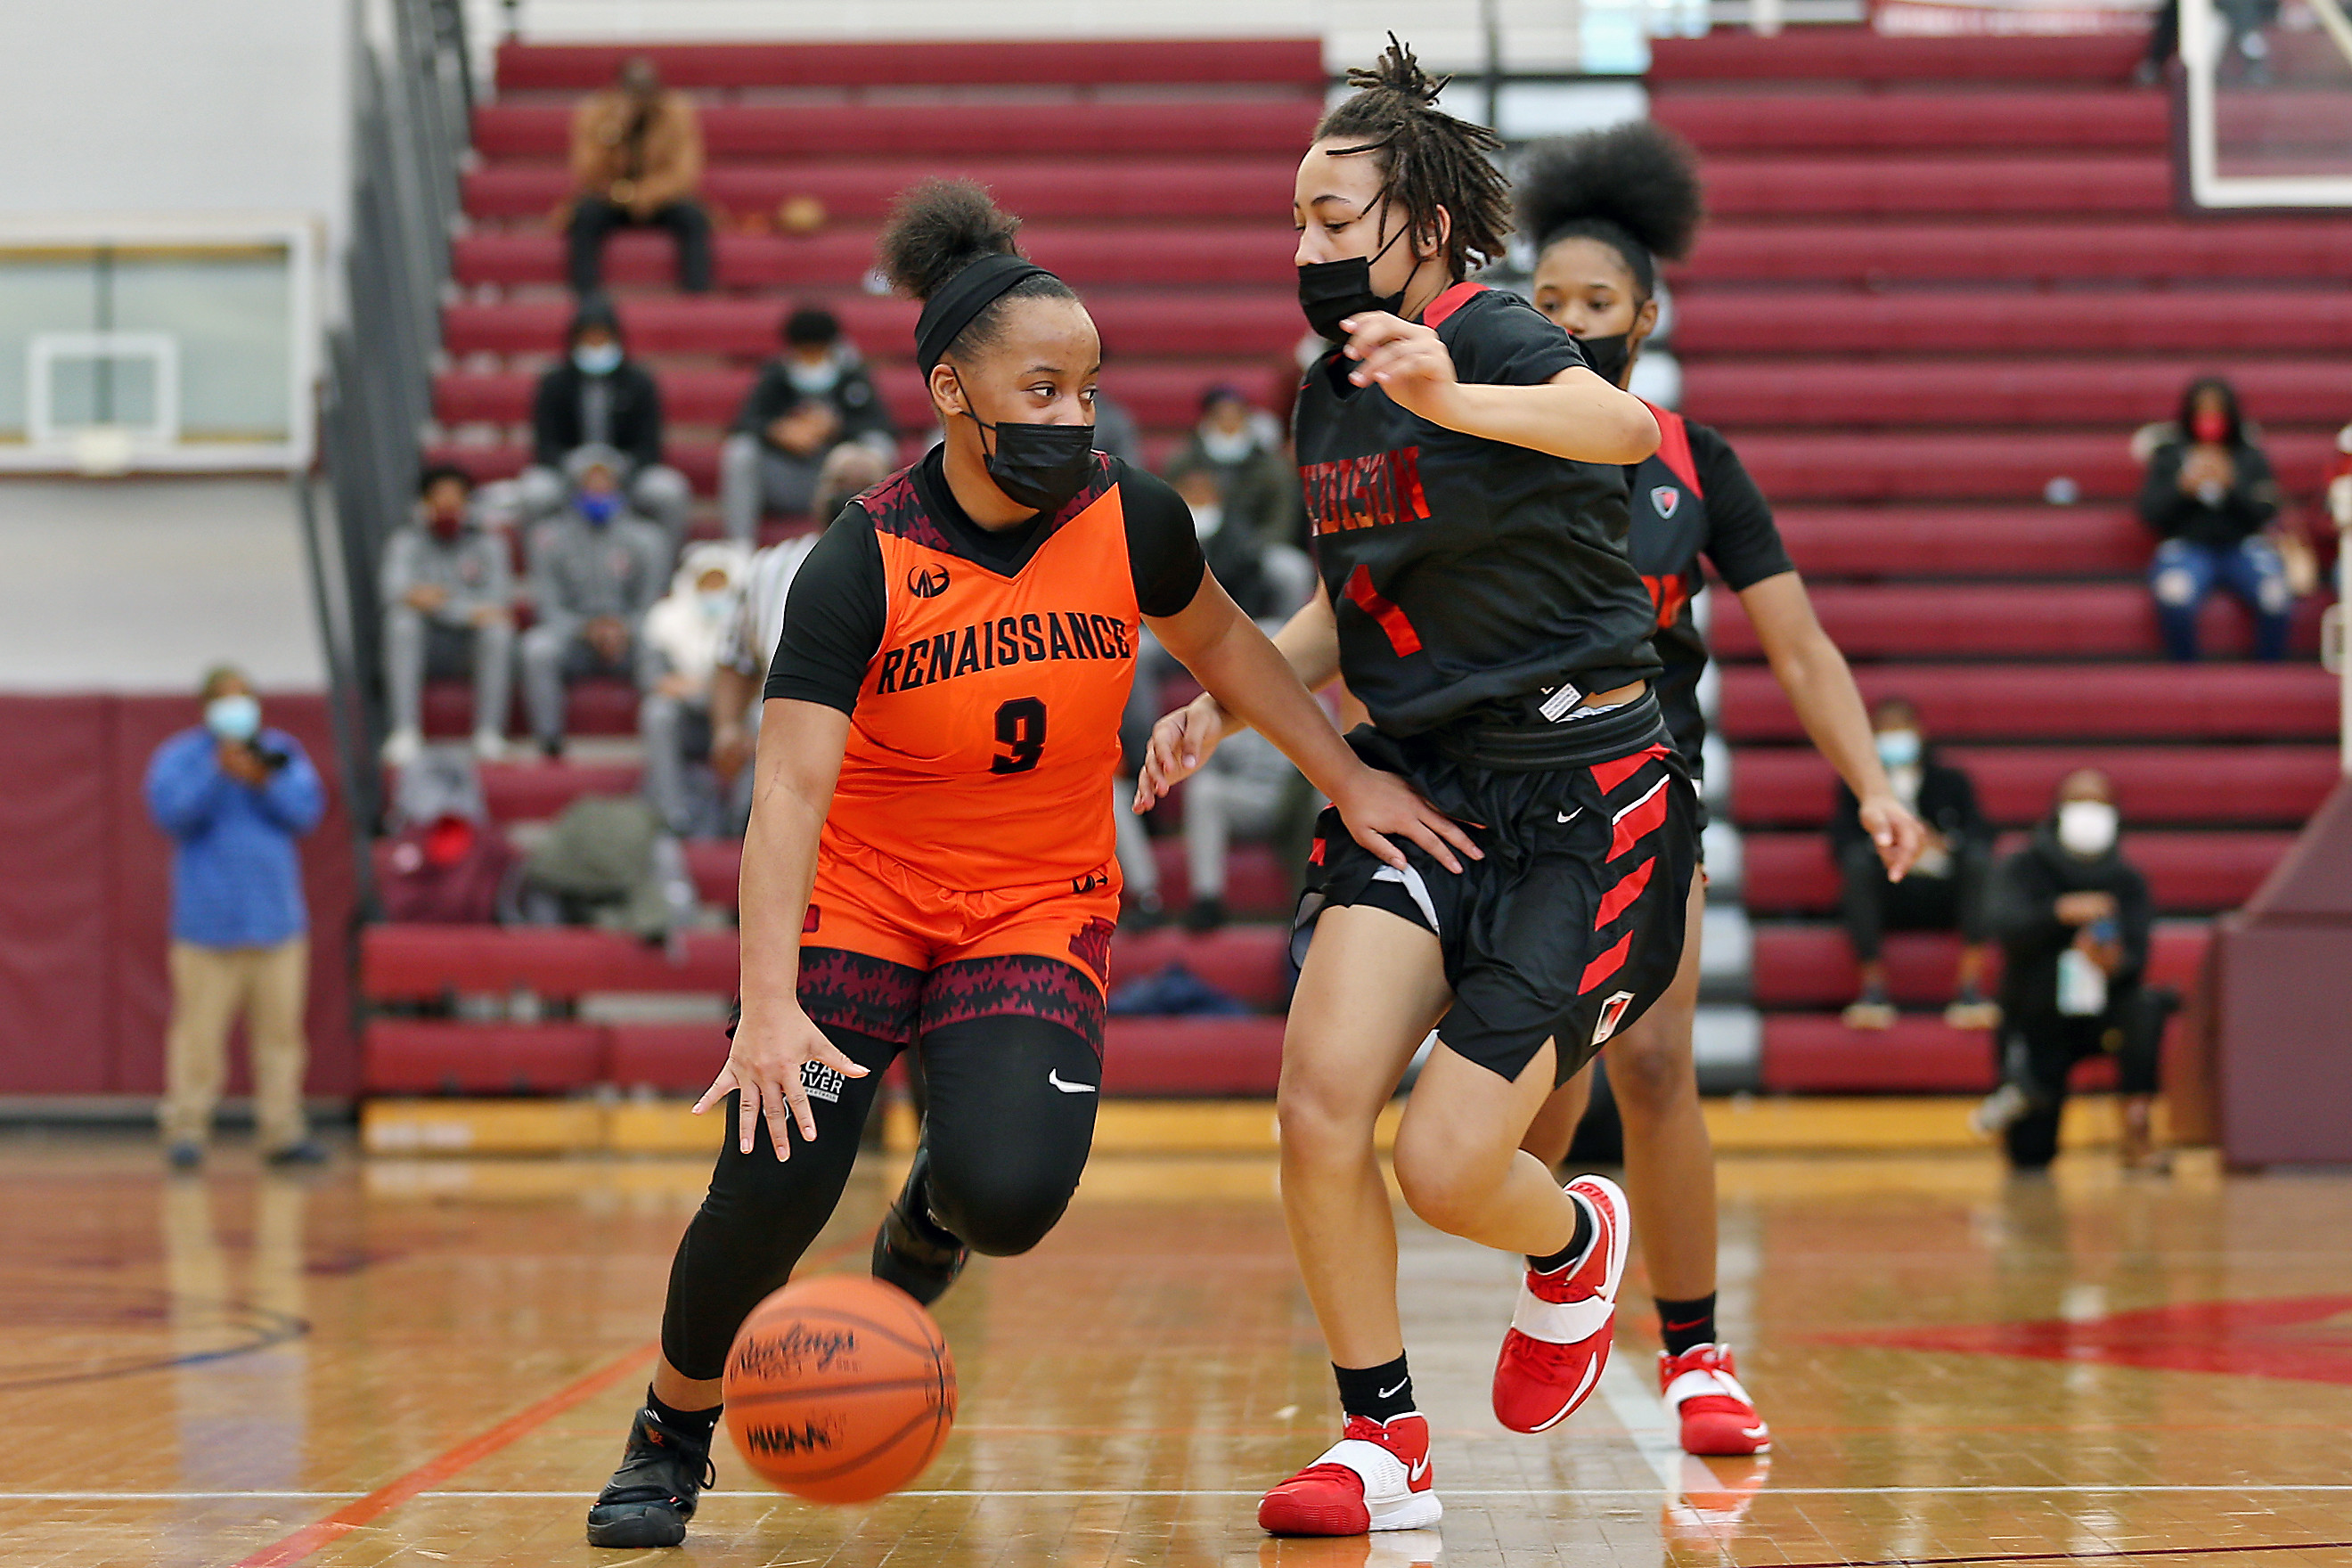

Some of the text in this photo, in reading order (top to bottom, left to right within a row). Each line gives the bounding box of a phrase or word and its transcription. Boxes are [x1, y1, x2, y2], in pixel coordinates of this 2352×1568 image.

[1298, 445, 1432, 537] EDISON
[878, 612, 1131, 694] RENAISSANCE
[1343, 564, 1424, 658] 1
